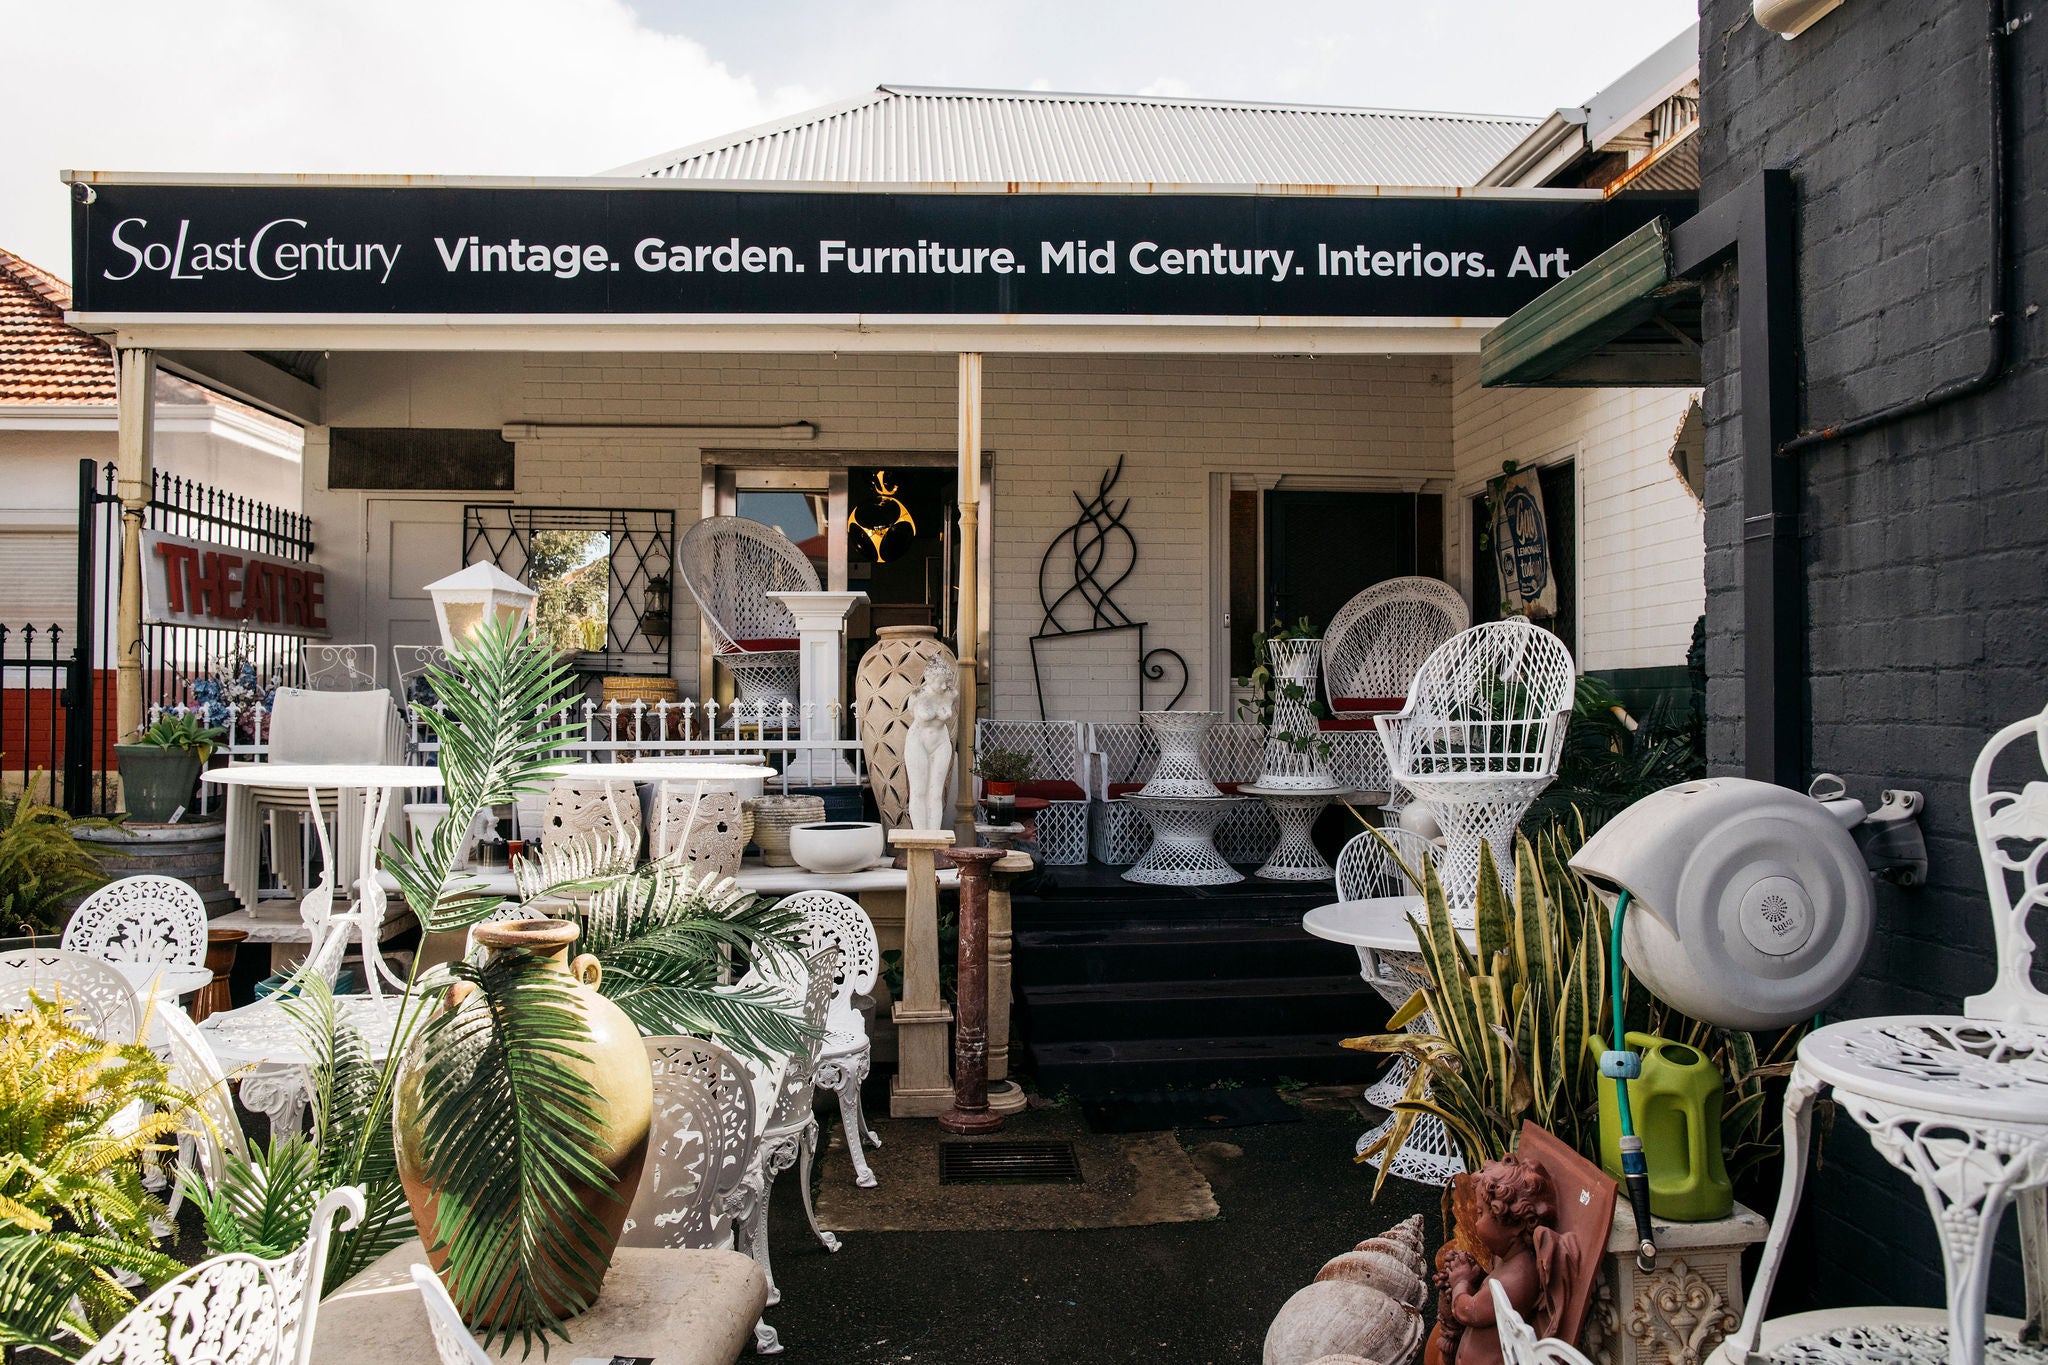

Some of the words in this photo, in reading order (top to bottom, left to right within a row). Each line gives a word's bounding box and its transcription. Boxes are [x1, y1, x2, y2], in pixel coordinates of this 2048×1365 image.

[433, 237, 620, 279] Vintage.
[633, 237, 805, 273] Garden.
[819, 239, 1026, 274] Furniture.
[1040, 239, 1116, 275] Mid
[1129, 241, 1305, 283] Century.
[1318, 242, 1495, 278] Interiors.
[1507, 245, 1577, 279] Art
[157, 541, 327, 629] THEATRE
[1772, 918, 1794, 934] Aqua
